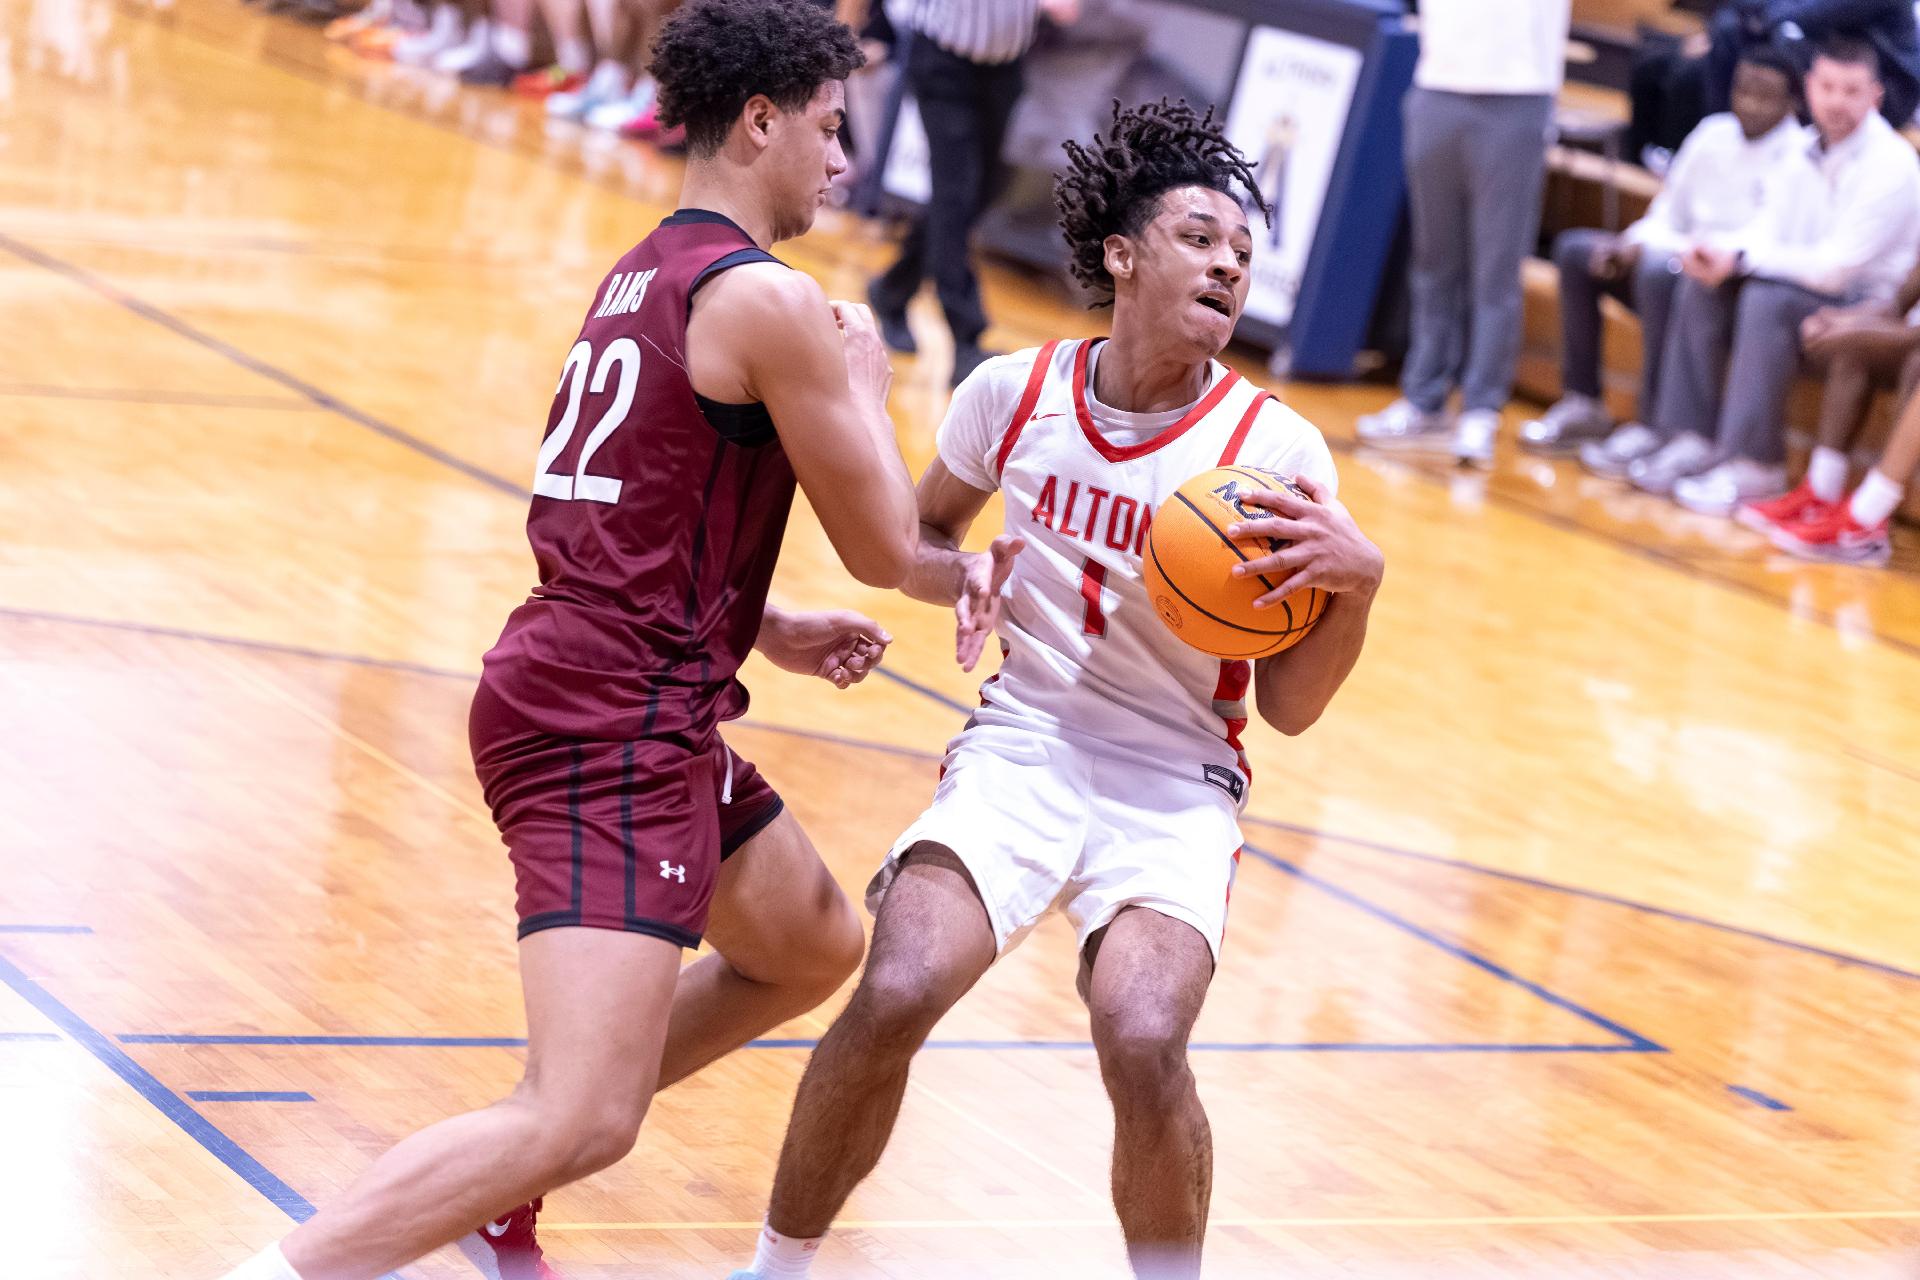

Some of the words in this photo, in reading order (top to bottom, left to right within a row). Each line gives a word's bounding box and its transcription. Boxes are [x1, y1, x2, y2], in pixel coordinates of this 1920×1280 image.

[593, 267, 659, 319] RAMS
[532, 337, 641, 504] 22
[1077, 556, 1109, 639] 1
